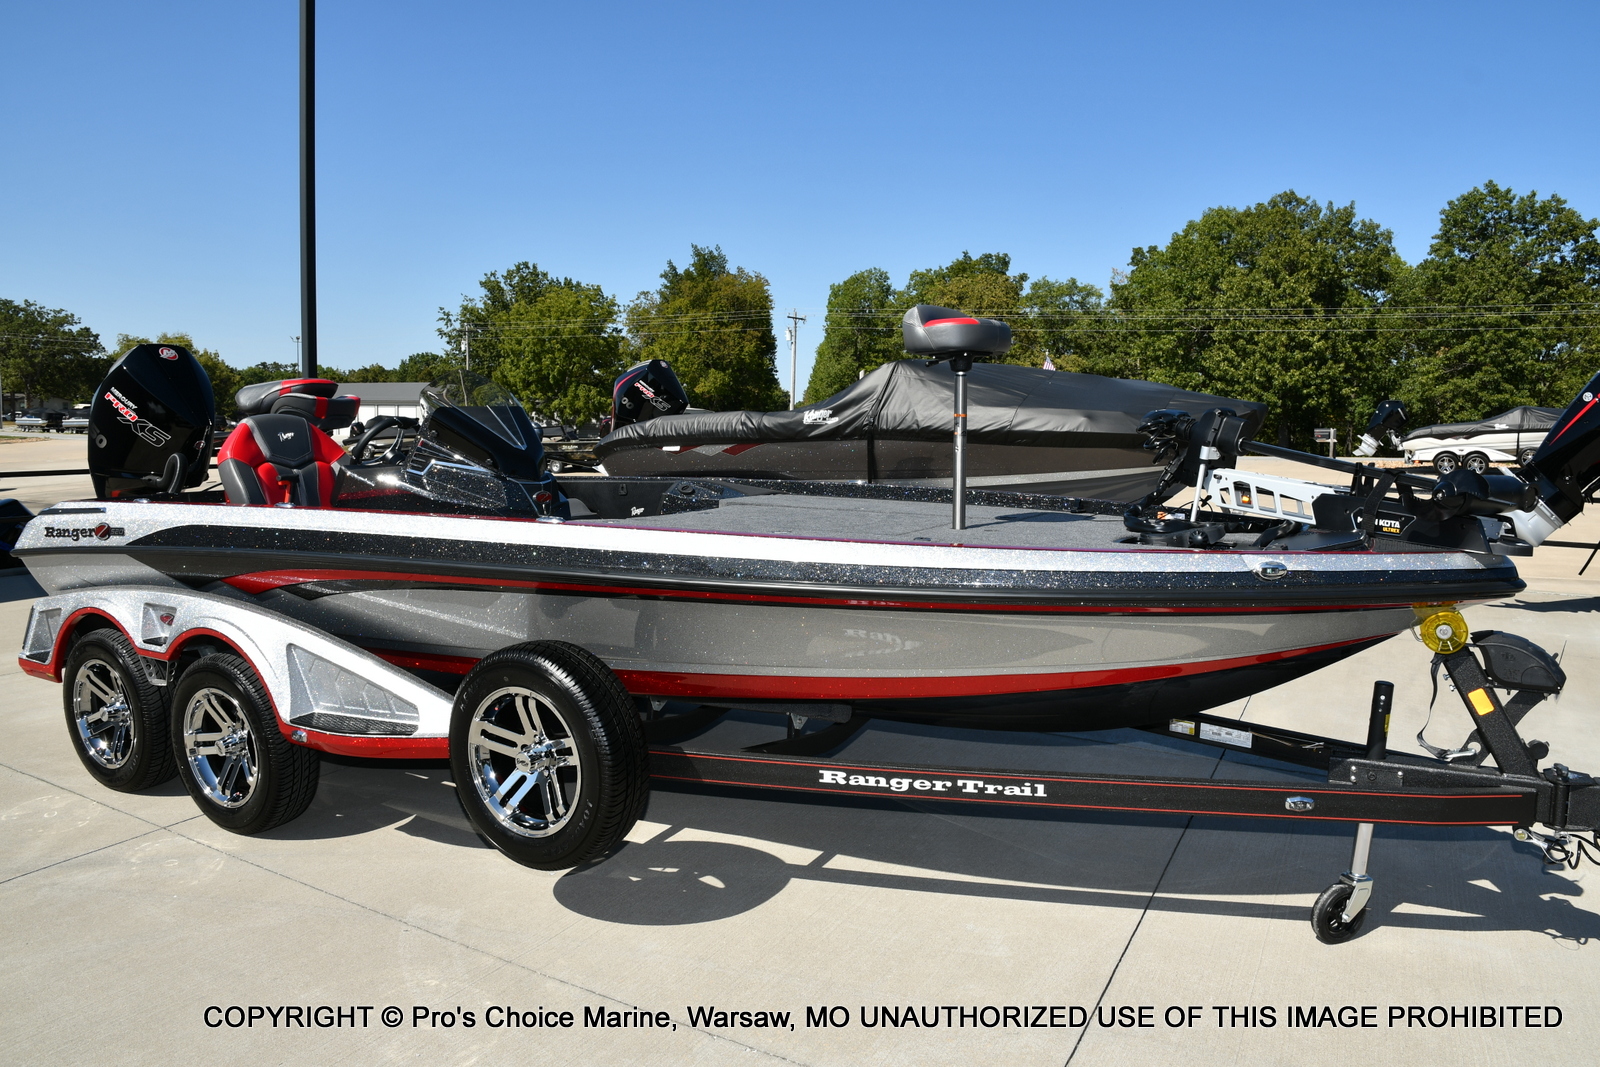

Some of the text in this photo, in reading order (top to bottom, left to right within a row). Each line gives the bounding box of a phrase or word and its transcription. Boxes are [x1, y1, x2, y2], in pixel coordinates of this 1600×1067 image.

[104, 391, 138, 423] PRO
[110, 386, 138, 410] MERCURY
[116, 416, 172, 448] XS
[44, 526, 96, 542] Ranger
[1379, 519, 1400, 528] KOTA
[818, 769, 1048, 797] Ranger Trail
